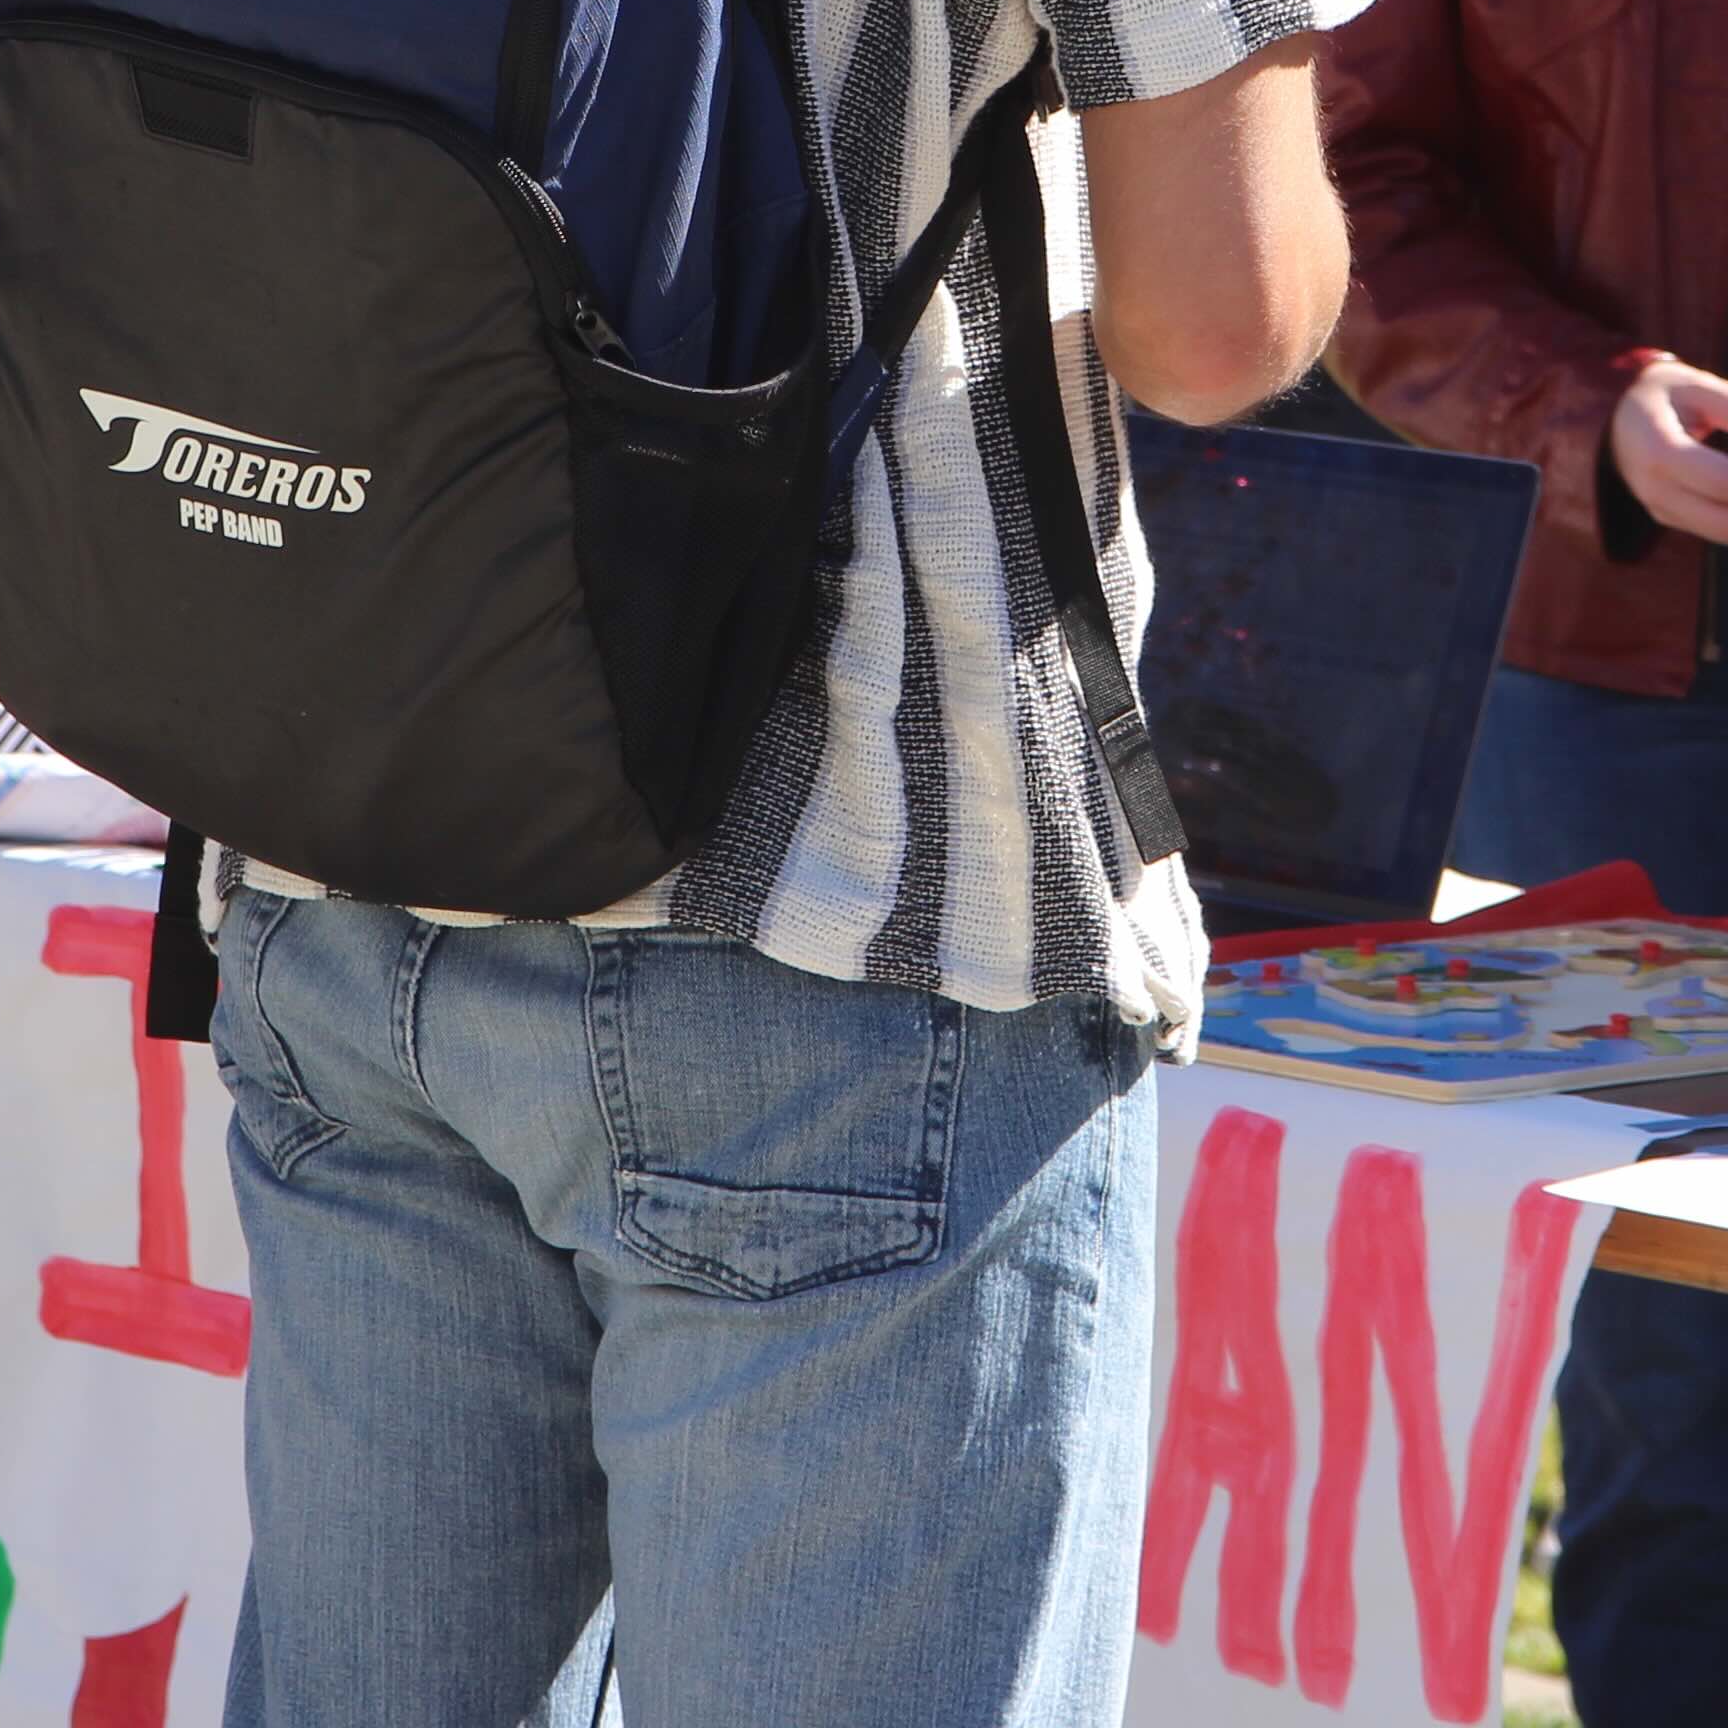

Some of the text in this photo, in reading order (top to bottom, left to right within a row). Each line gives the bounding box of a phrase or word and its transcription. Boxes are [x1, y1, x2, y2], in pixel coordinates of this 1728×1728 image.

[79, 387, 372, 514] TOREROS
[179, 497, 284, 548] PEP BAND
